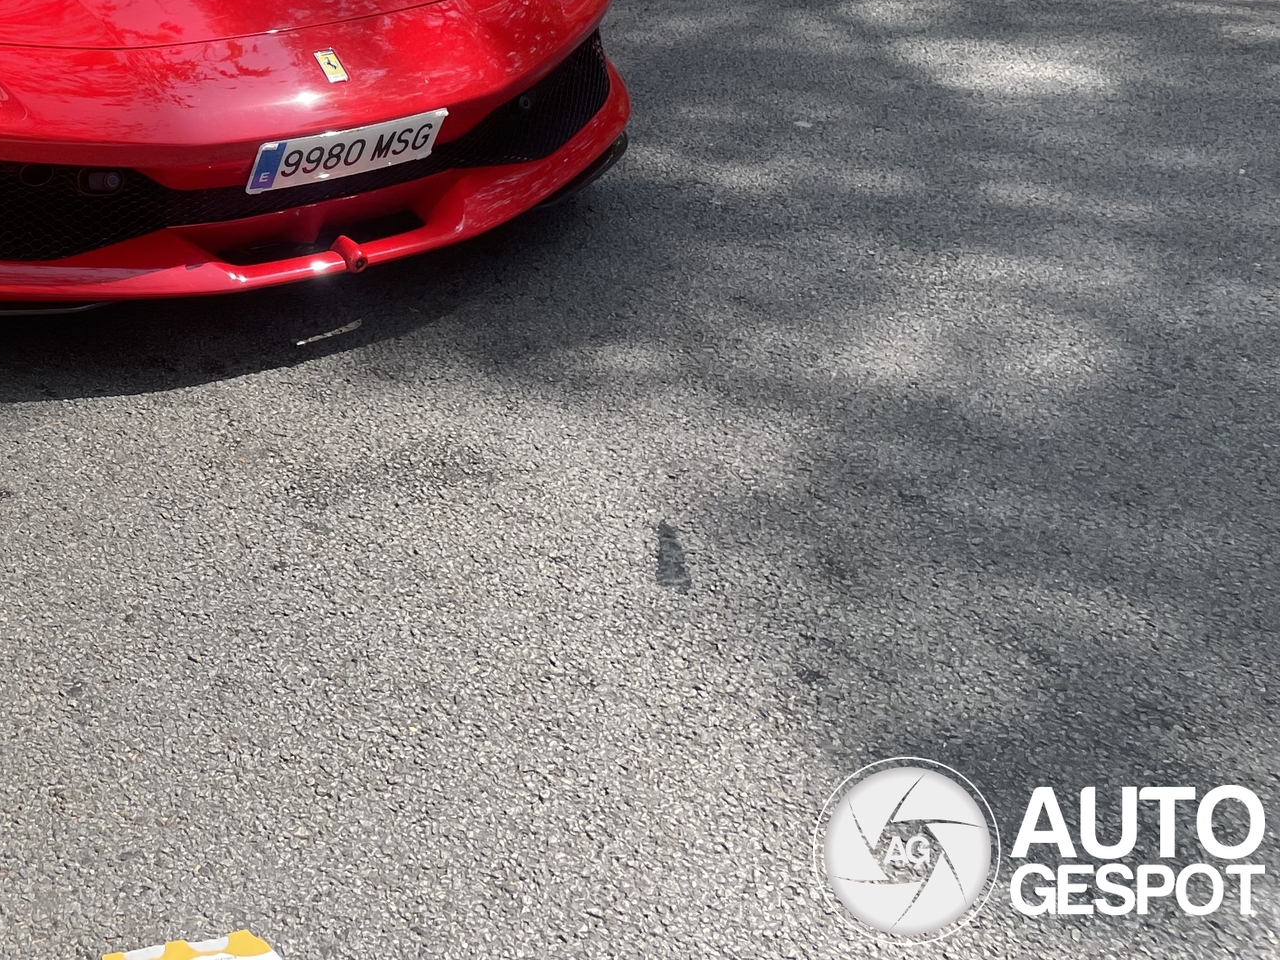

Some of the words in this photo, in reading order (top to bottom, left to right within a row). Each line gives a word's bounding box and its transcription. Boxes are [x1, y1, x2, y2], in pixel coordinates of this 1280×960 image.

[281, 139, 366, 177] 9980
[370, 123, 433, 161] MSG
[258, 172, 270, 183] E
